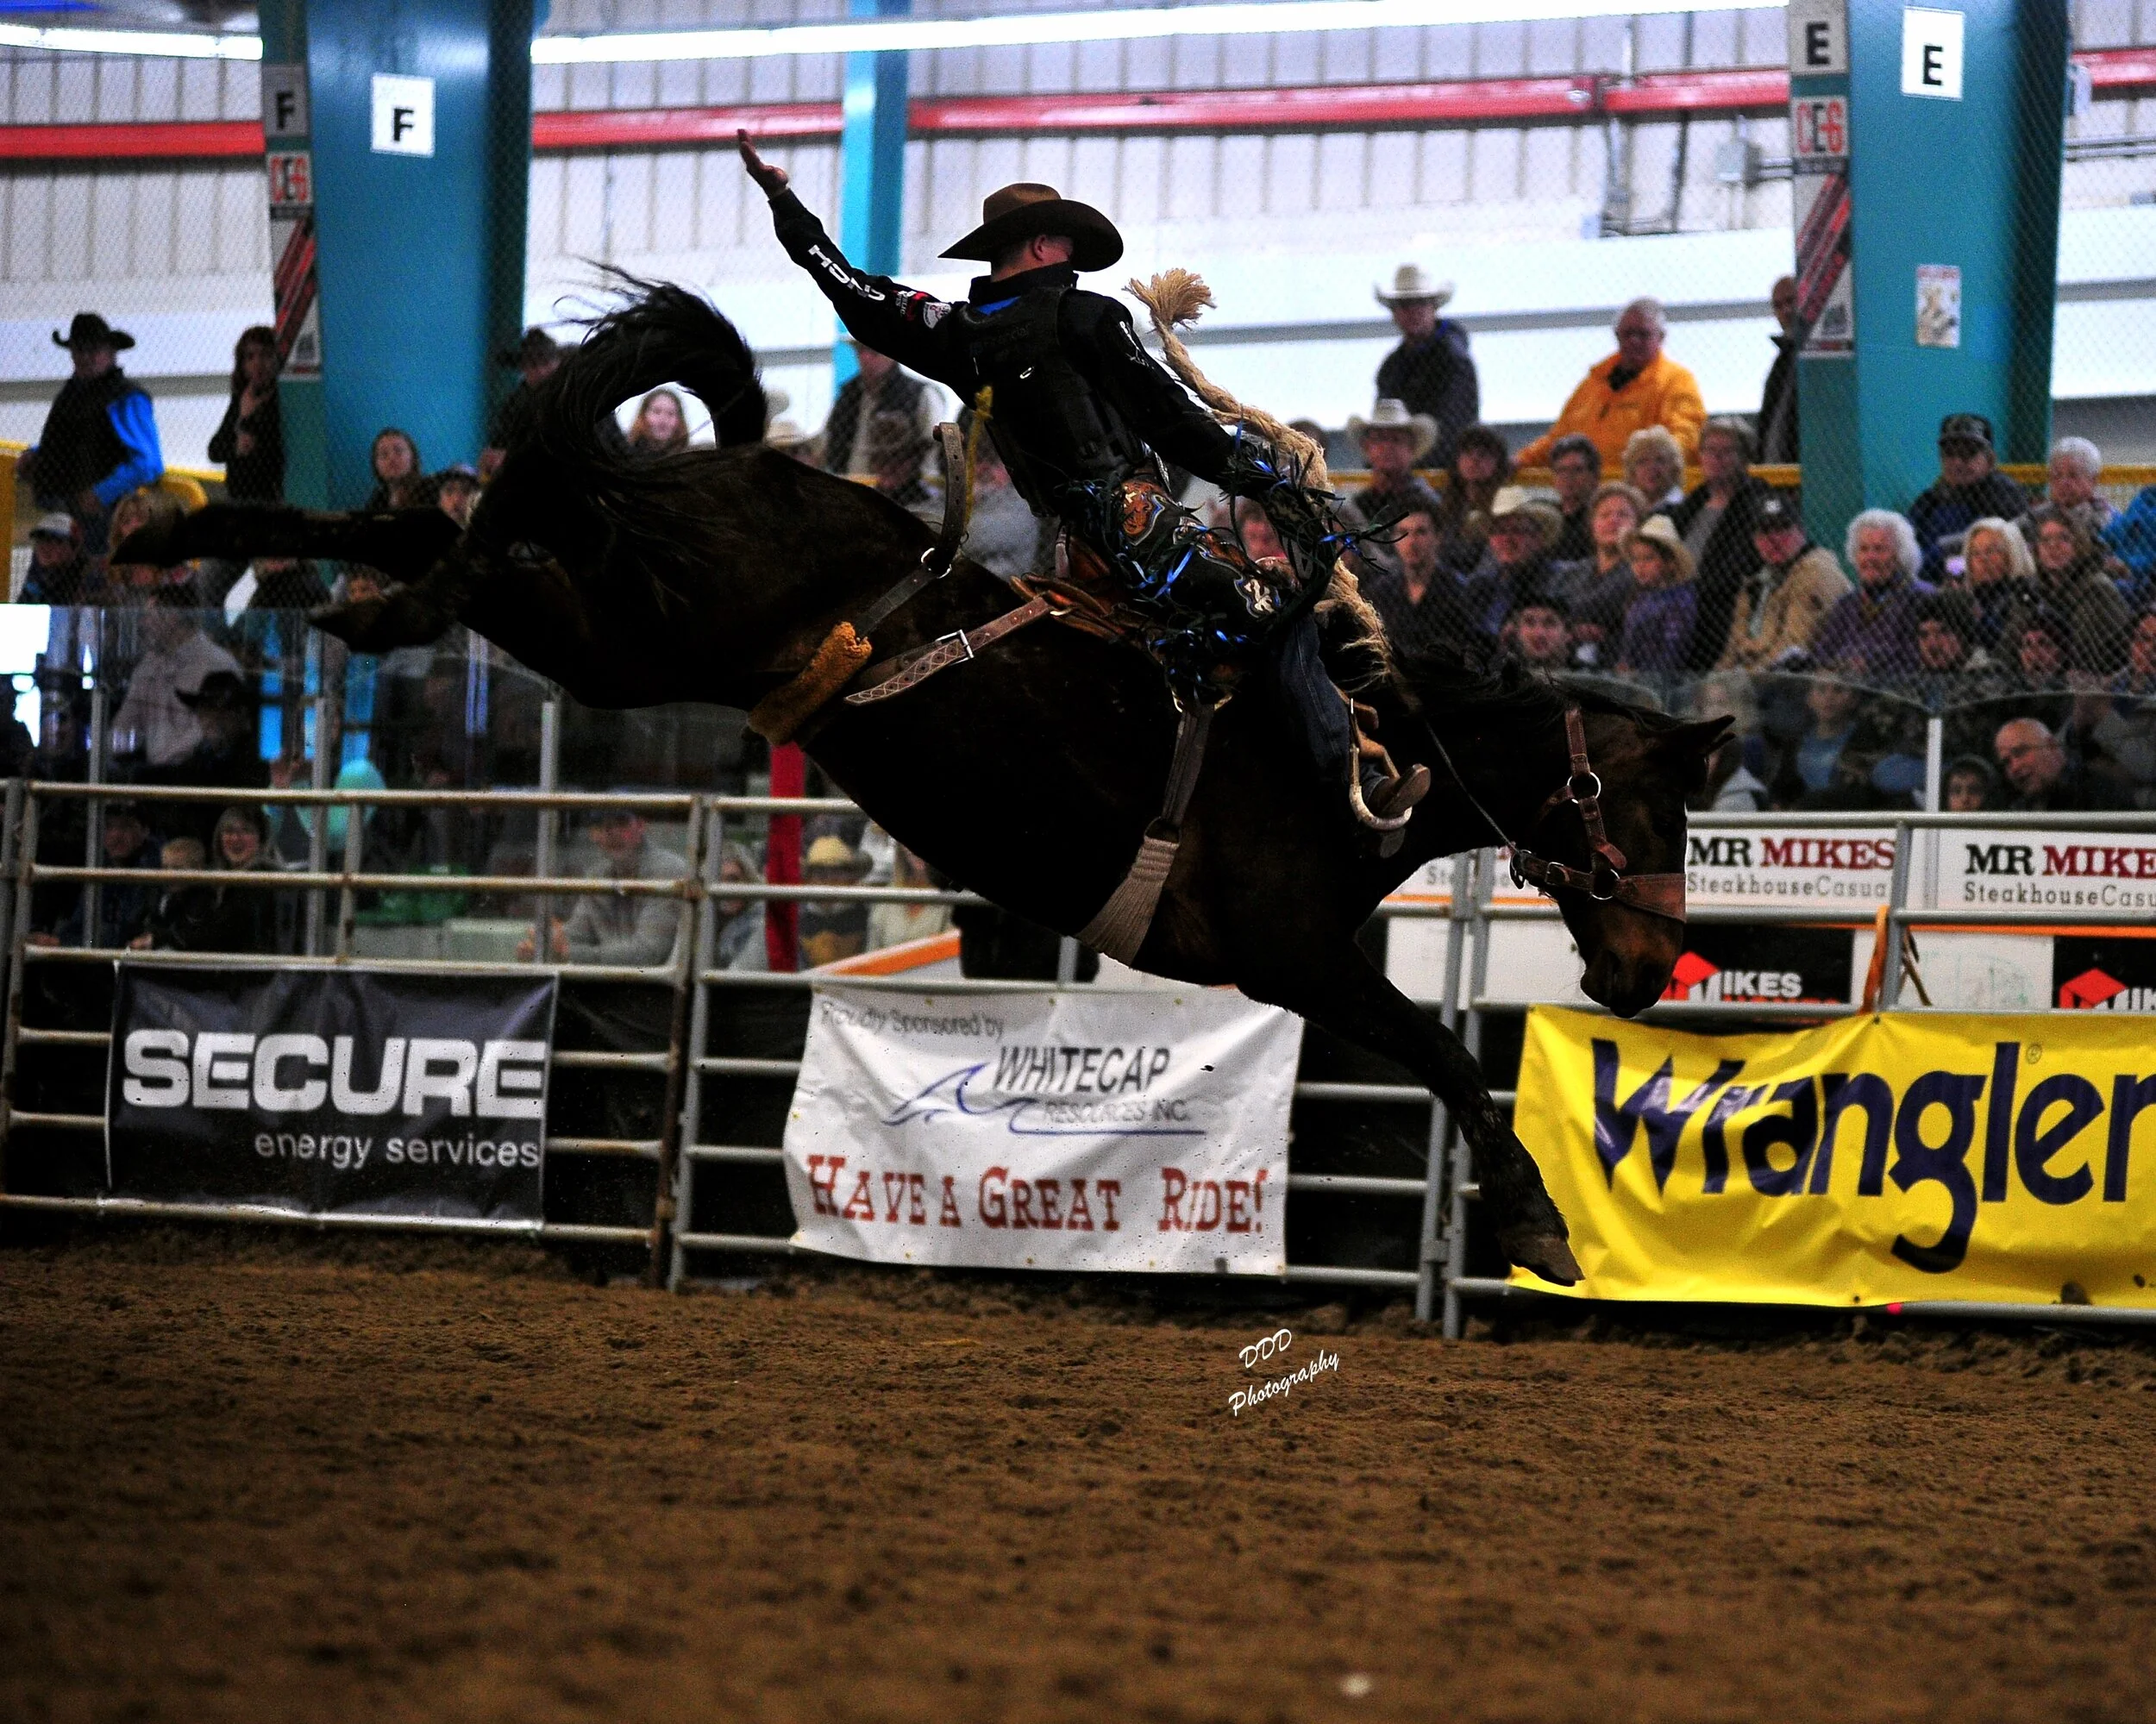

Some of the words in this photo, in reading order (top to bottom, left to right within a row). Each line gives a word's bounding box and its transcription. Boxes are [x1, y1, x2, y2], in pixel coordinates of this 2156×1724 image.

[1806, 22, 1830, 66] E
[1922, 45, 1944, 86] E
[276, 91, 293, 130] F
[393, 108, 414, 141] F
[1688, 836, 1752, 868] MR
[1760, 837, 1896, 870] MIKES
[1965, 843, 2034, 875] MR
[122, 1029, 546, 1119] SECURE
[992, 1045, 1171, 1093] WHITECAP
[255, 1132, 373, 1169] energy
[385, 1132, 540, 1167] services
[1591, 1038, 2156, 1274] Wrangler
[807, 1155, 925, 1226] HAVE
[939, 1175, 962, 1227] A
[978, 1167, 1120, 1232] GREAT
[1157, 1168, 1269, 1233] RIDE!
